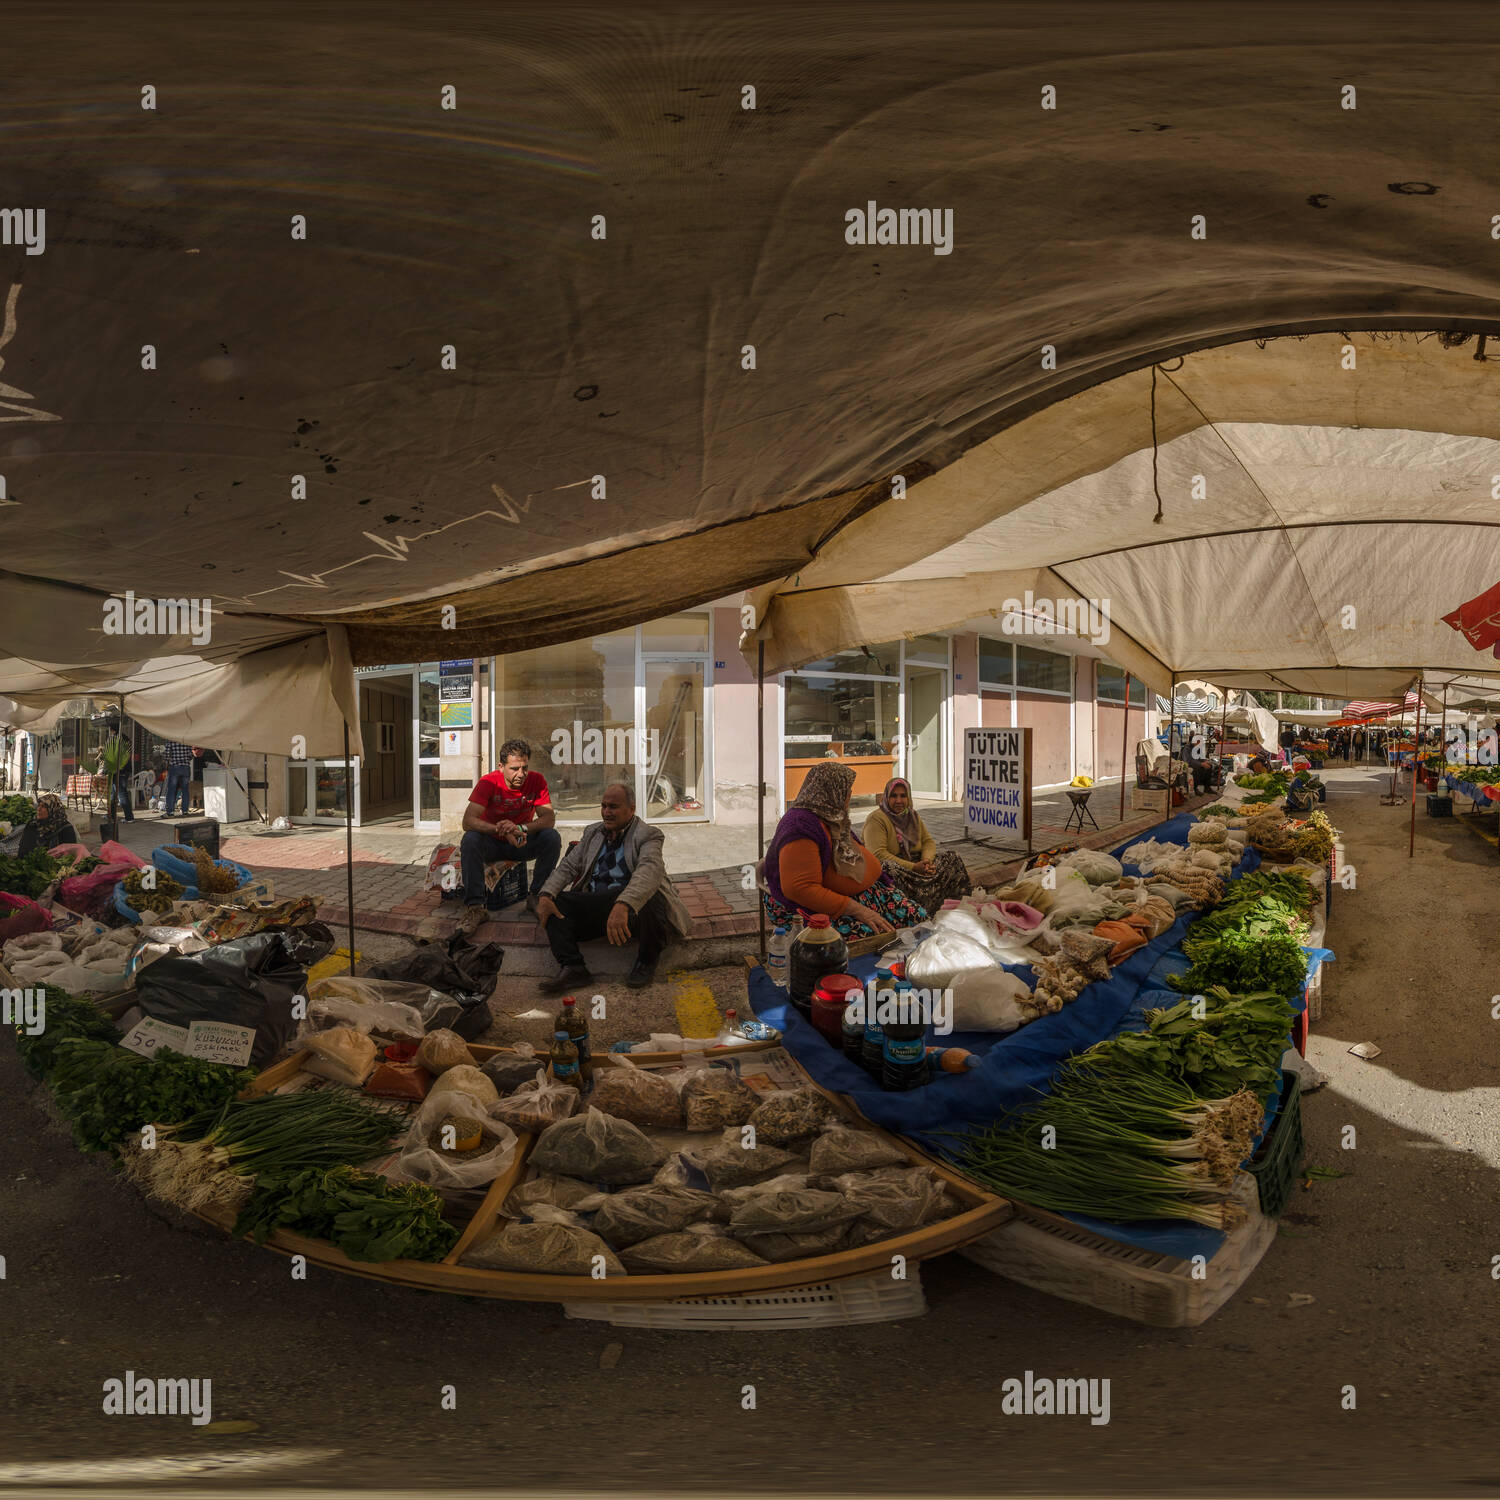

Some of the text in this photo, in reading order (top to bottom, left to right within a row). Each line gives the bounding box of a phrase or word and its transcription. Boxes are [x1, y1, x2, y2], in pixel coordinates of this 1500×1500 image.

[968, 733, 1019, 756] TÜTÜN
[969, 805, 1018, 829] OYUNCAK
[133, 1031, 156, 1048] 50
